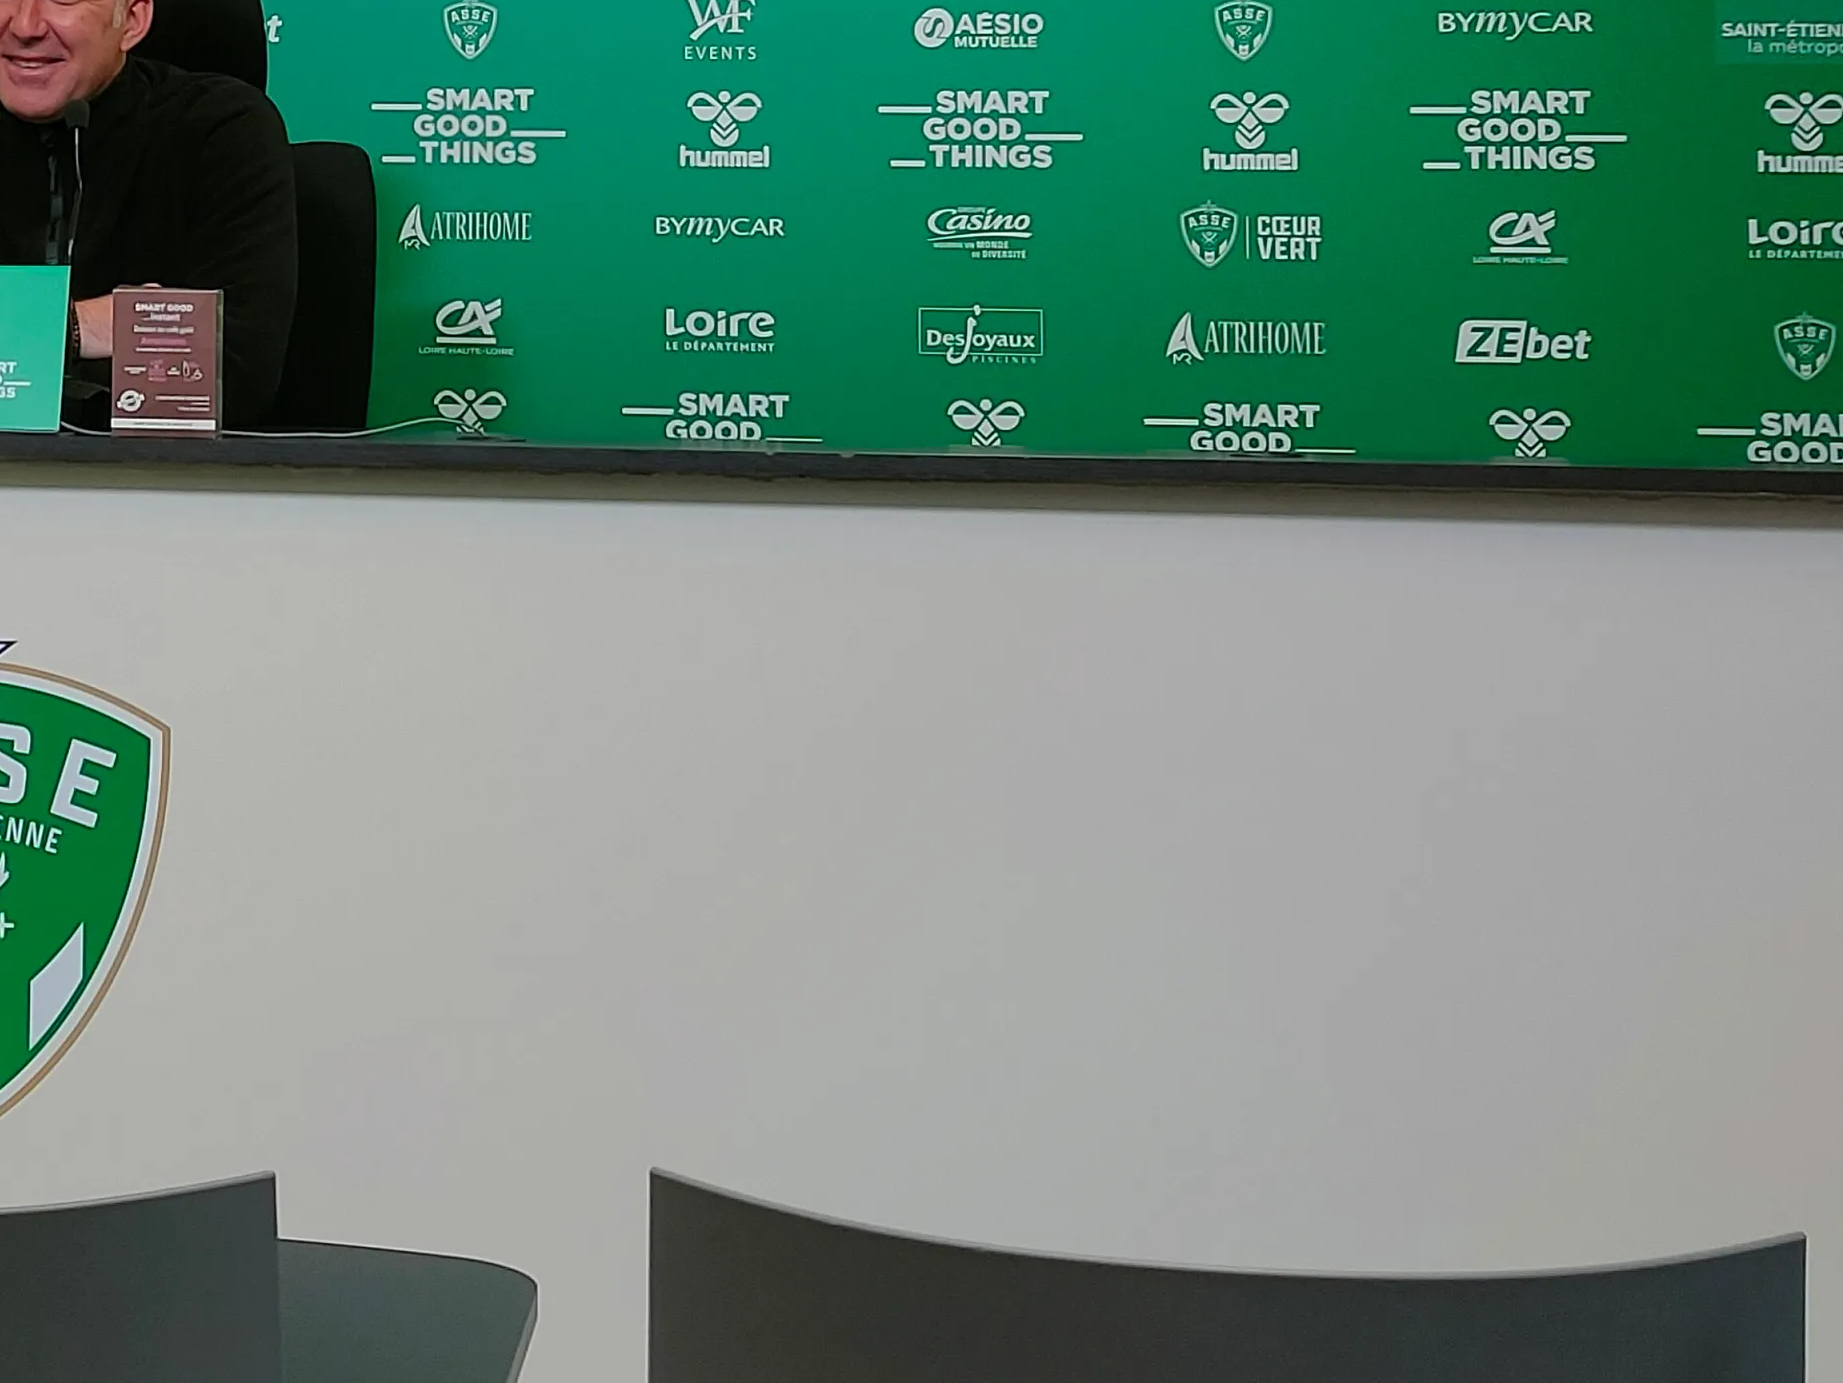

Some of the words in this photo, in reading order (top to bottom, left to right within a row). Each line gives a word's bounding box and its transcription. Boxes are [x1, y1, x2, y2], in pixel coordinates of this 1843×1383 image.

[451, 9, 490, 23] ASSE
[1222, 8, 1265, 22] ASSE
[685, 46, 756, 60] EVENTS
[954, 36, 1037, 47] MUTUELLE
[1748, 39, 1763, 53] la
[427, 88, 534, 111] SMART
[936, 90, 1049, 114] SMART
[1470, 90, 1591, 114] SMART
[414, 114, 507, 137] GOOD
[923, 117, 1021, 141] GOOD
[1457, 118, 1561, 142] GOOD
[419, 141, 536, 164] THINGS
[680, 145, 769, 167] hummel
[929, 144, 1052, 168] THINGS
[1203, 148, 1298, 170] hummel
[1464, 146, 1595, 170] THINGS
[1758, 150, 1843, 173] humme
[431, 212, 531, 240] ATRIHOME
[928, 207, 1032, 239] Casino
[1188, 213, 1231, 229] ASSE
[1257, 237, 1322, 260] VERT
[1749, 250, 1761, 258] LE
[167, 304, 193, 312] GOOD
[666, 309, 775, 337] Loire
[1783, 325, 1828, 342] ASSE
[666, 341, 678, 350] LE
[684, 340, 774, 352] DÉPARTEMENT
[1204, 321, 1325, 354] ATRIHOME
[678, 393, 789, 417] SMART
[1204, 403, 1320, 427] SMART
[666, 419, 761, 440] GOOD
[1190, 430, 1291, 452] GOOD
